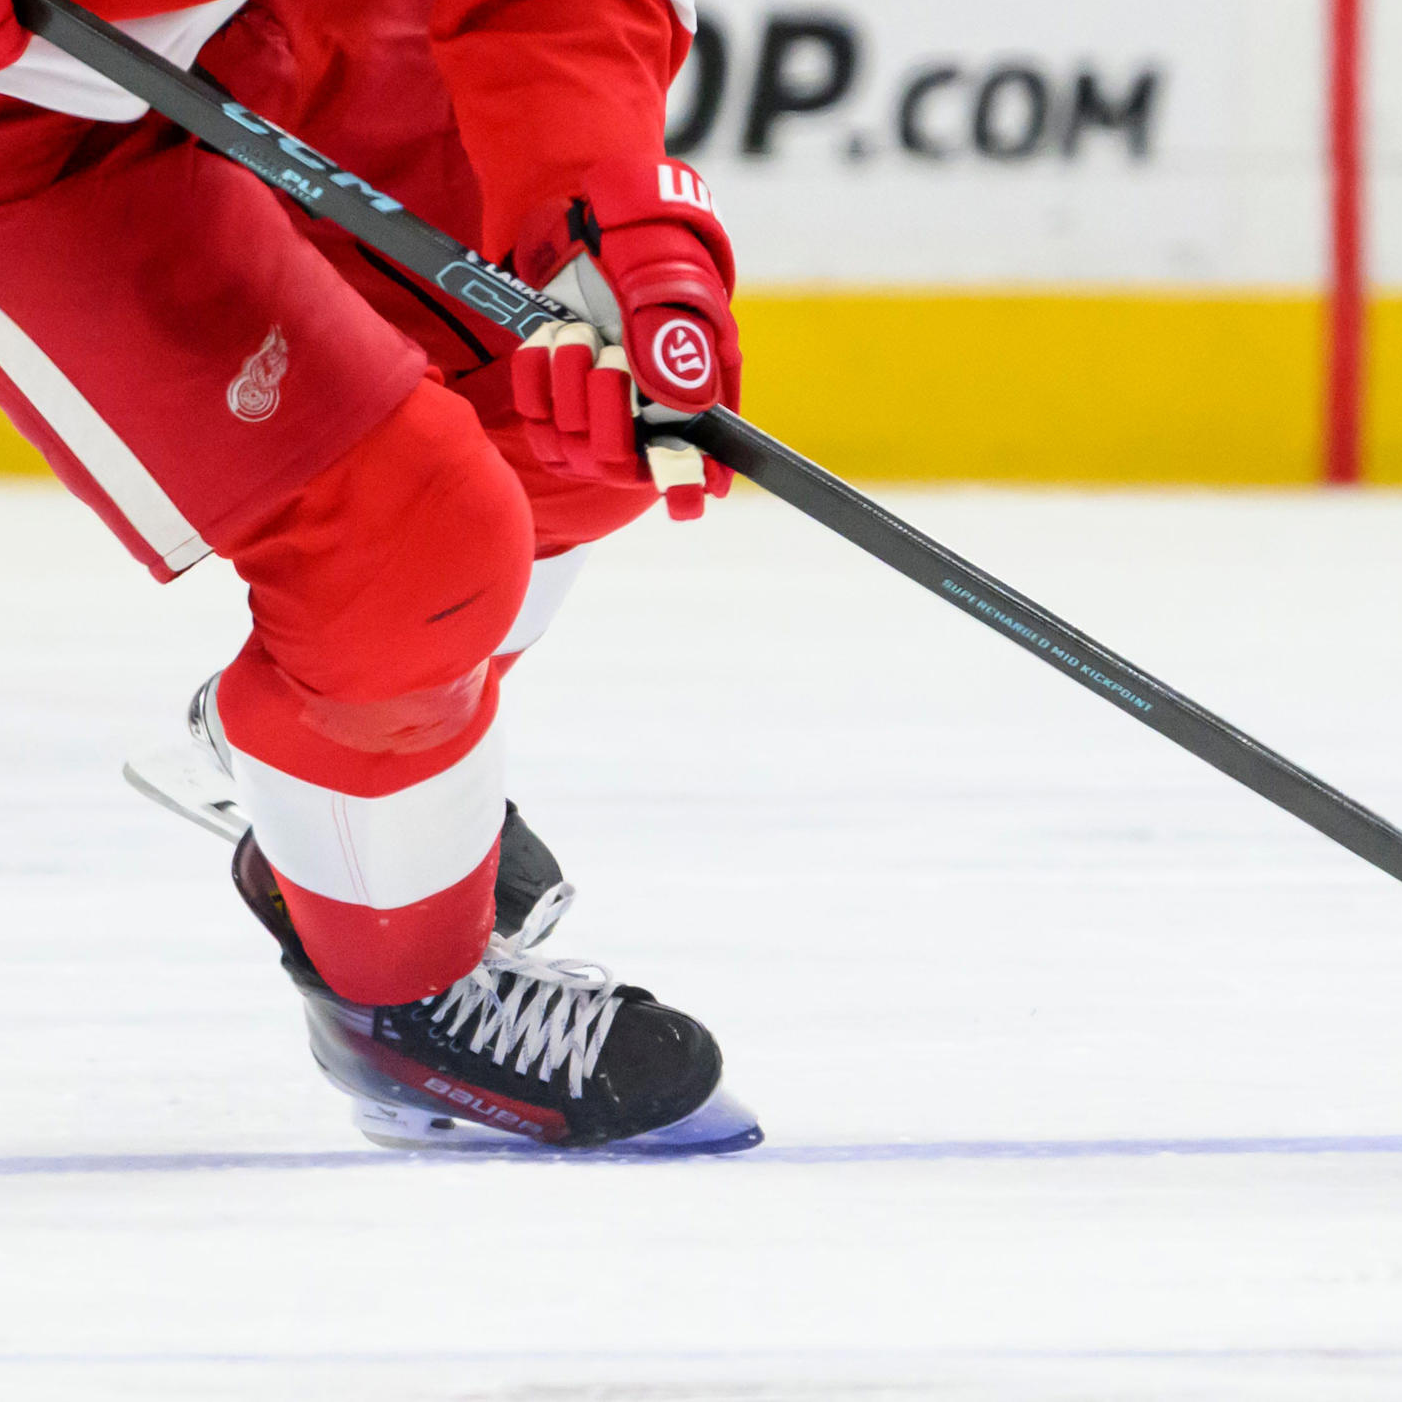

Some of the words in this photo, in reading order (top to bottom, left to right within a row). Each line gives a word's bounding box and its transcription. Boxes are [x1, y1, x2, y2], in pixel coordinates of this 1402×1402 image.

[222, 102, 405, 213] CCM
[483, 262, 561, 311] LARKIN
[941, 578, 1051, 650] SUPERCHARGED
[1051, 645, 1080, 667] MID
[1080, 664, 1154, 712] KICKPOINT
